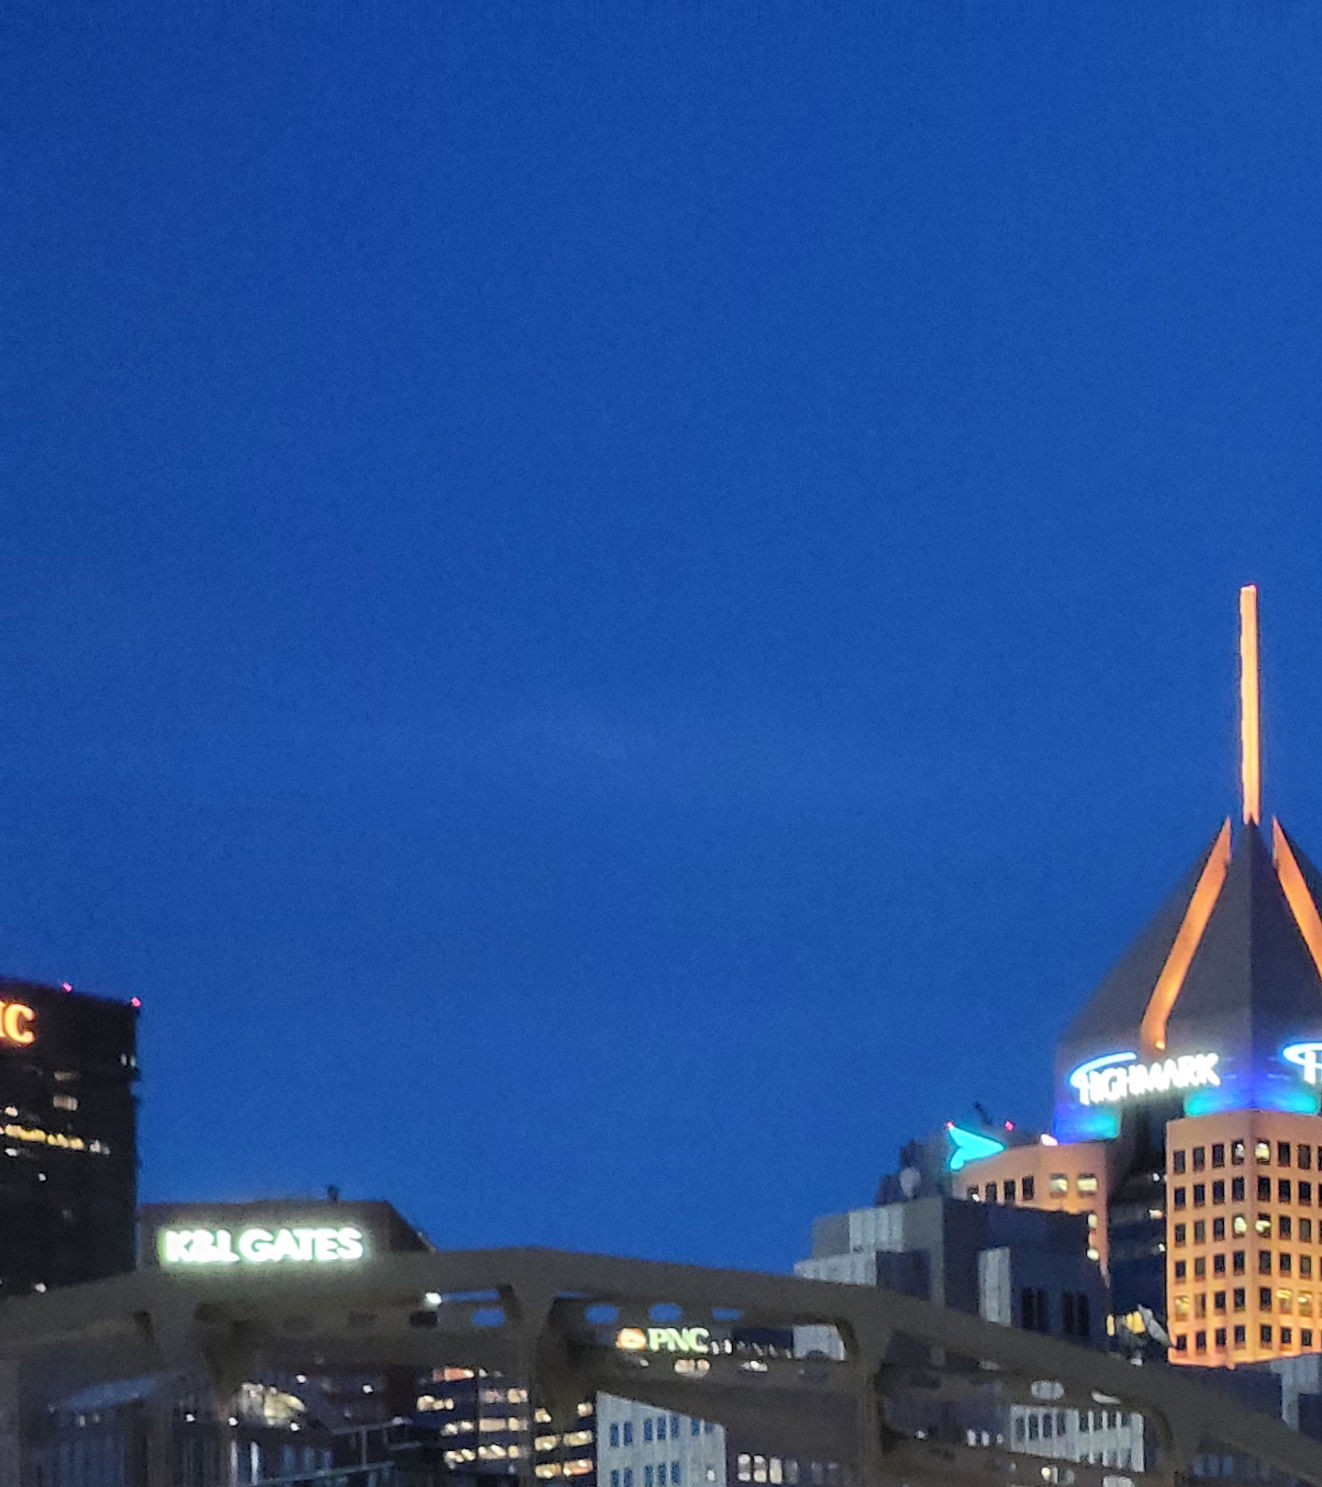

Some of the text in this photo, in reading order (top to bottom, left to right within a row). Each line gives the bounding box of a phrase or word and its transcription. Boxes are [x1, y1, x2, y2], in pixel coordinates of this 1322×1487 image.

[0, 1001, 35, 1044] C
[162, 1226, 364, 1263] K&L GATES
[647, 1326, 710, 1353] PNC
